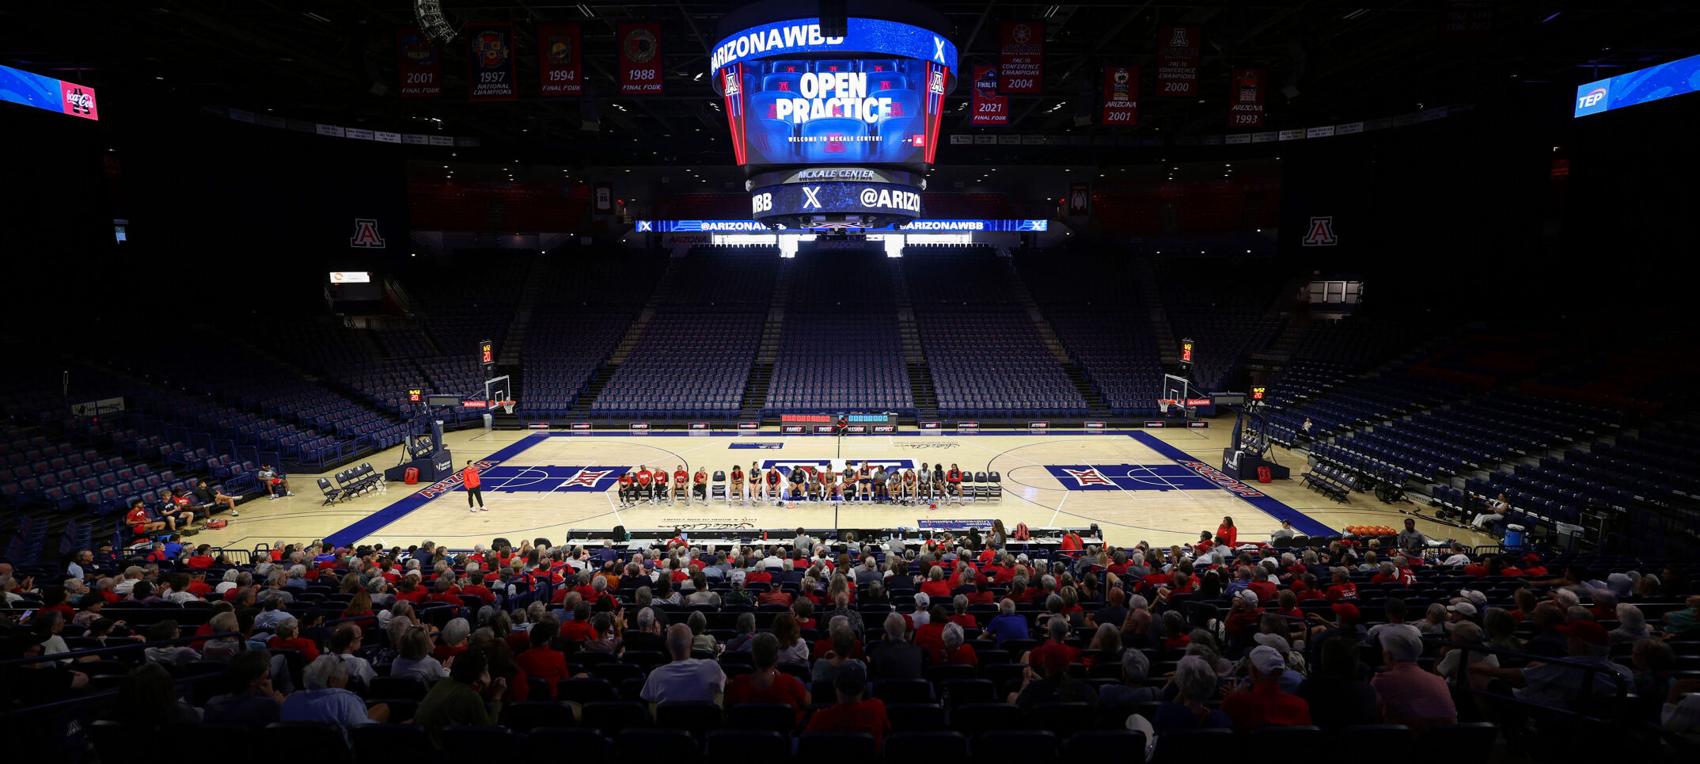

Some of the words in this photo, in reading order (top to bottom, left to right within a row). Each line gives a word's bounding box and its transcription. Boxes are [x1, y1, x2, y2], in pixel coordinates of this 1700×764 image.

[408, 72, 433, 83] 2001
[480, 72, 506, 82] 1997
[549, 70, 575, 81] 1994
[629, 69, 655, 80] 1988
[800, 72, 867, 98] OPEN
[1008, 79, 1033, 88] 2004
[1164, 82, 1189, 92] 2000
[1105, 101, 1137, 109] ARIZONA
[1578, 92, 1603, 109] TEP
[776, 98, 892, 124] PRACTICE
[979, 103, 1002, 112] 2021
[1108, 112, 1131, 121] 2001
[1235, 114, 1258, 124] 1993
[799, 169, 836, 178] MCKALE
[839, 169, 875, 178] CENTER
